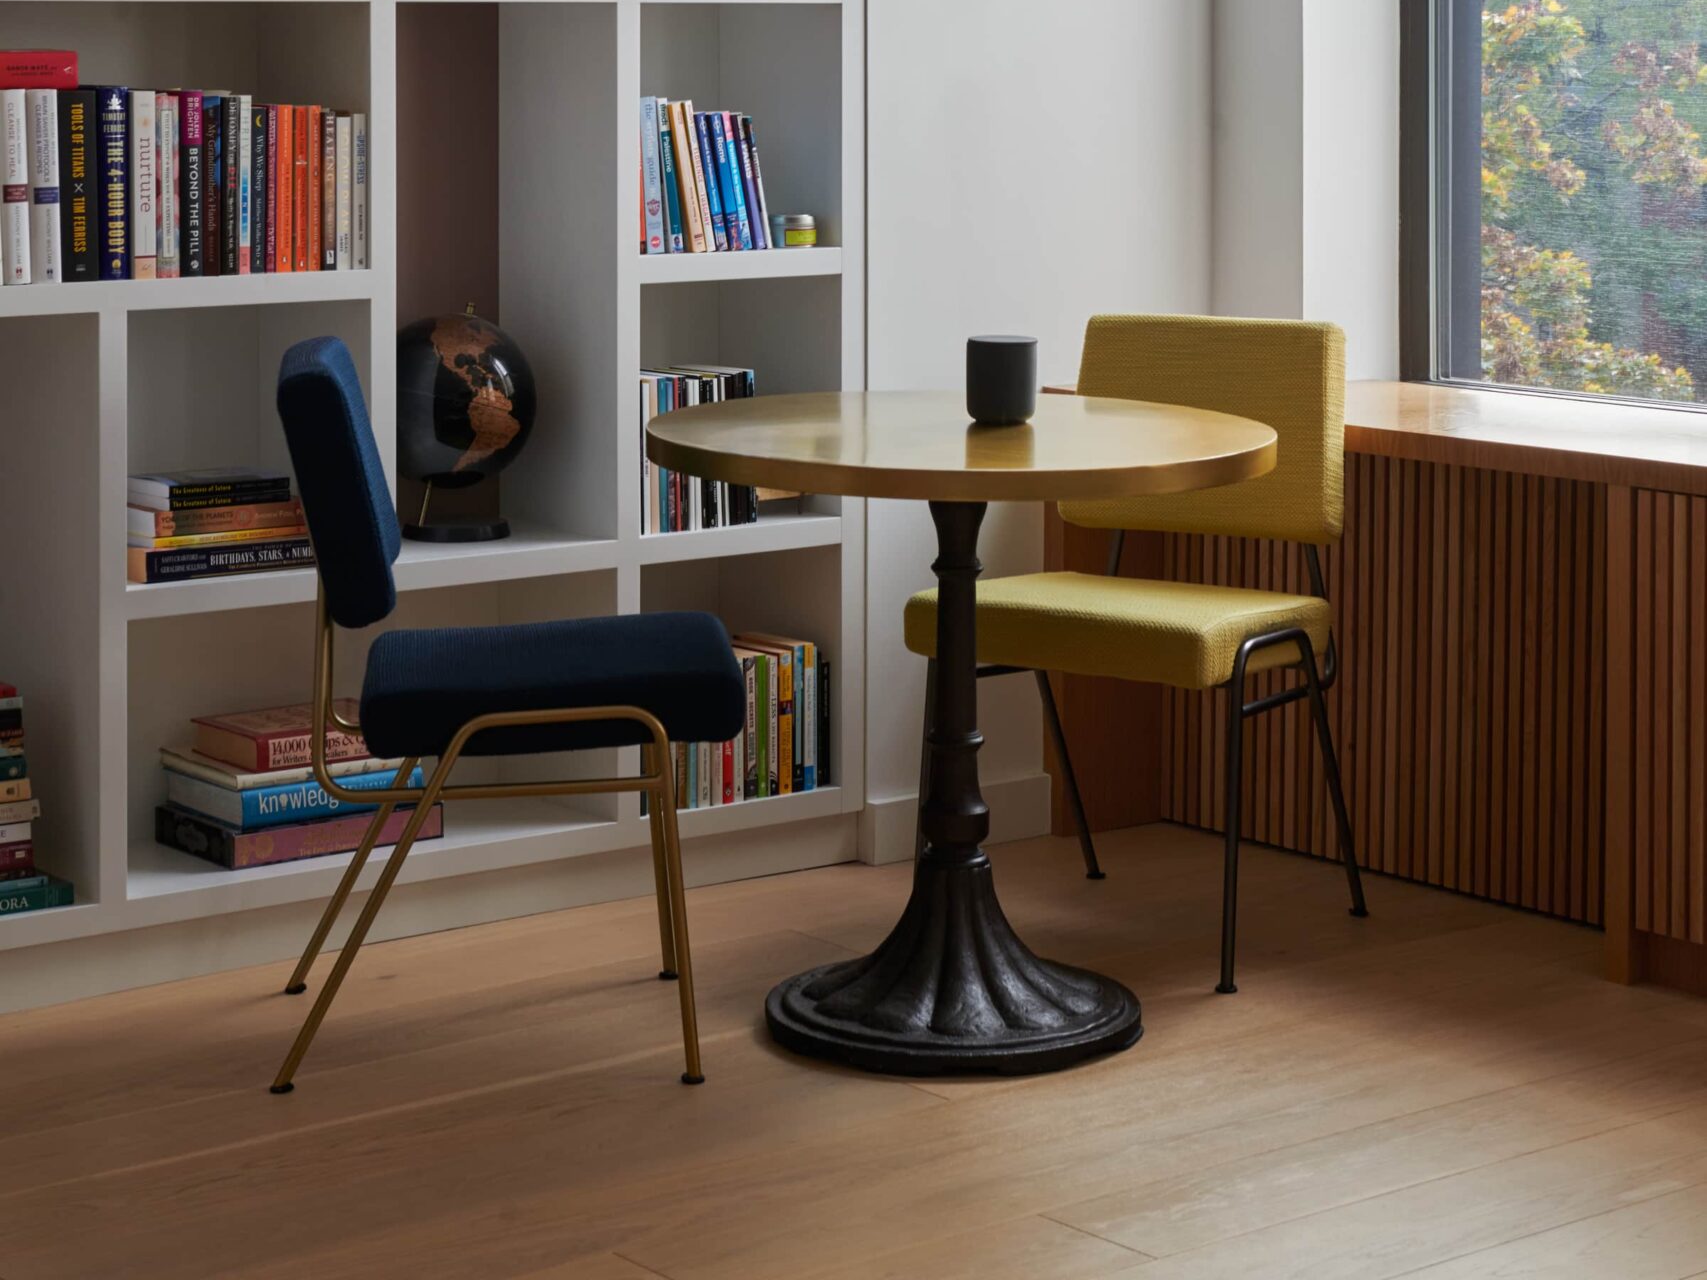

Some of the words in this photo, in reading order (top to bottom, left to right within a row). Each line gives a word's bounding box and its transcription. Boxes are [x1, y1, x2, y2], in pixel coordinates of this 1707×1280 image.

[71, 103, 84, 130] TOOLS
[645, 104, 654, 120] the
[72, 133, 84, 144] OF
[206, 124, 216, 138] My
[8, 144, 15, 154] TO
[108, 140, 124, 163] THE
[357, 135, 365, 157] UPSIDE
[662, 136, 672, 173] Palestine
[717, 136, 726, 163] Rome
[72, 147, 85, 177] TITANS
[189, 148, 198, 199] BEYOND
[207, 140, 216, 202] Grandmother's
[256, 156, 264, 168] We
[644, 157, 656, 185] guide
[140, 137, 152, 213] nurture
[256, 170, 264, 191] Sleep
[108, 168, 124, 216] 4-HOUR
[73, 196, 86, 213] TIM
[189, 202, 198, 226] THE
[208, 205, 216, 231] Hands
[73, 216, 86, 252] FERRISS
[108, 221, 124, 254] BODY
[189, 230, 198, 254] PILL
[210, 553, 256, 566] BIRTHDAYS,
[258, 550, 284, 561] STARS,
[272, 739, 306, 755] 14,000
[342, 735, 352, 746] &
[272, 756, 284, 765] for
[284, 754, 307, 764] Writers
[259, 783, 339, 815] knowledg
